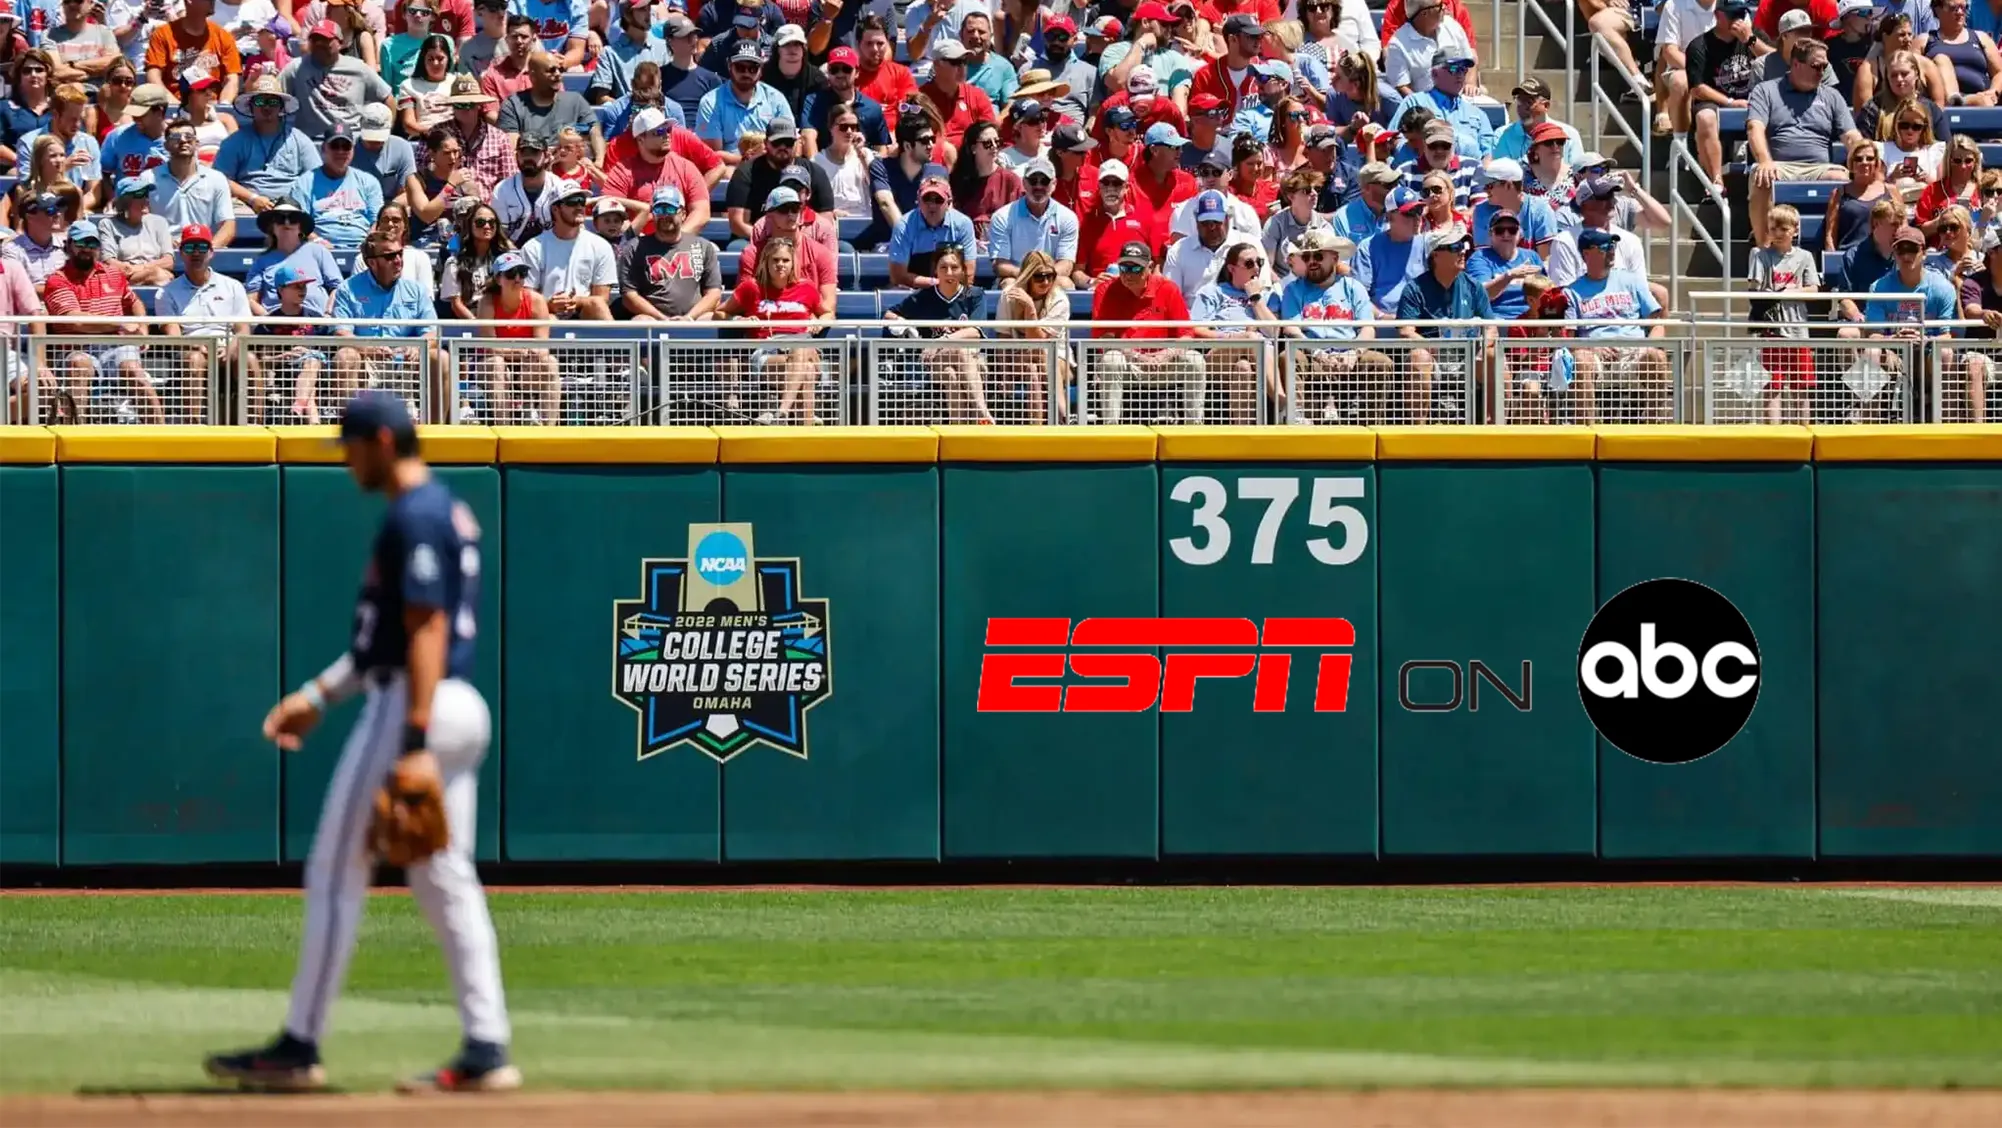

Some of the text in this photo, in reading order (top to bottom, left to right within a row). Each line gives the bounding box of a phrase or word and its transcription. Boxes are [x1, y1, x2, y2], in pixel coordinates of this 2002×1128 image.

[645, 251, 695, 285] M
[1168, 475, 1369, 565] 375
[700, 557, 746, 572] NCAA
[675, 615, 768, 628] 2022 MEN'S
[663, 631, 781, 660] COLLEGE
[623, 662, 823, 692] WORLD SERIES
[693, 696, 752, 709] OMAHA
